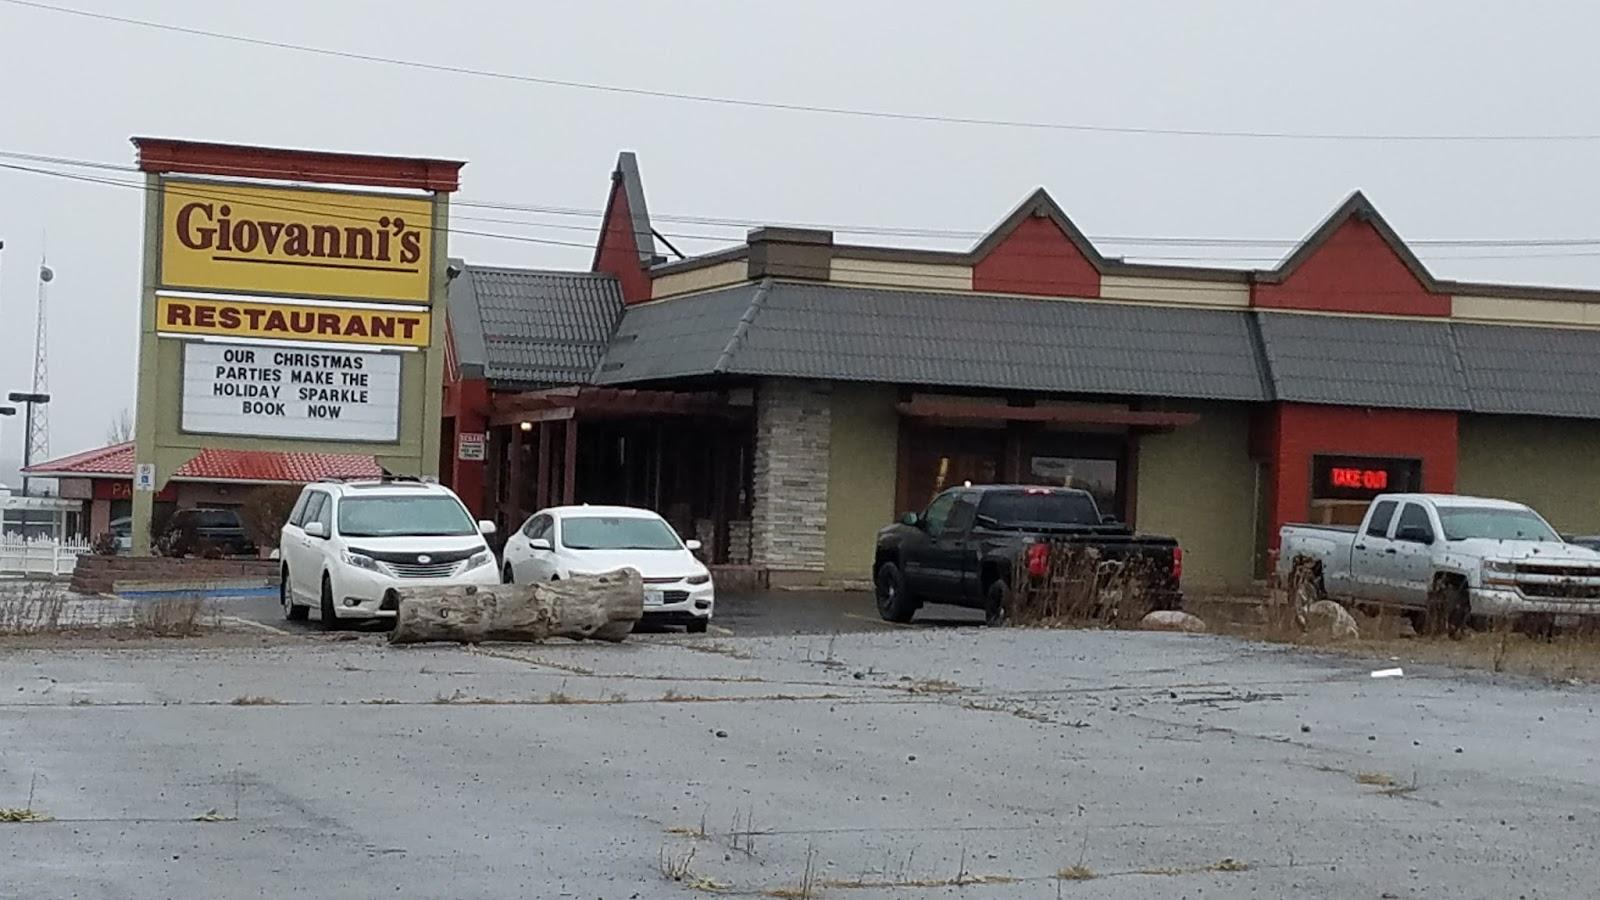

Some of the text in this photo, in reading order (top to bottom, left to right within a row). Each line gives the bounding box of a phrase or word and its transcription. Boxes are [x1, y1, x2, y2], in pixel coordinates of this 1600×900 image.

[176, 202, 421, 263] Giovanni's
[167, 304, 420, 338] RESTAURANT
[223, 350, 364, 369] OUR CHRISTMAS
[215, 366, 369, 386] PARTIES MAKE THE
[213, 383, 368, 403] HOLIDAY SPARKLE
[242, 401, 341, 418] BOOK NOW
